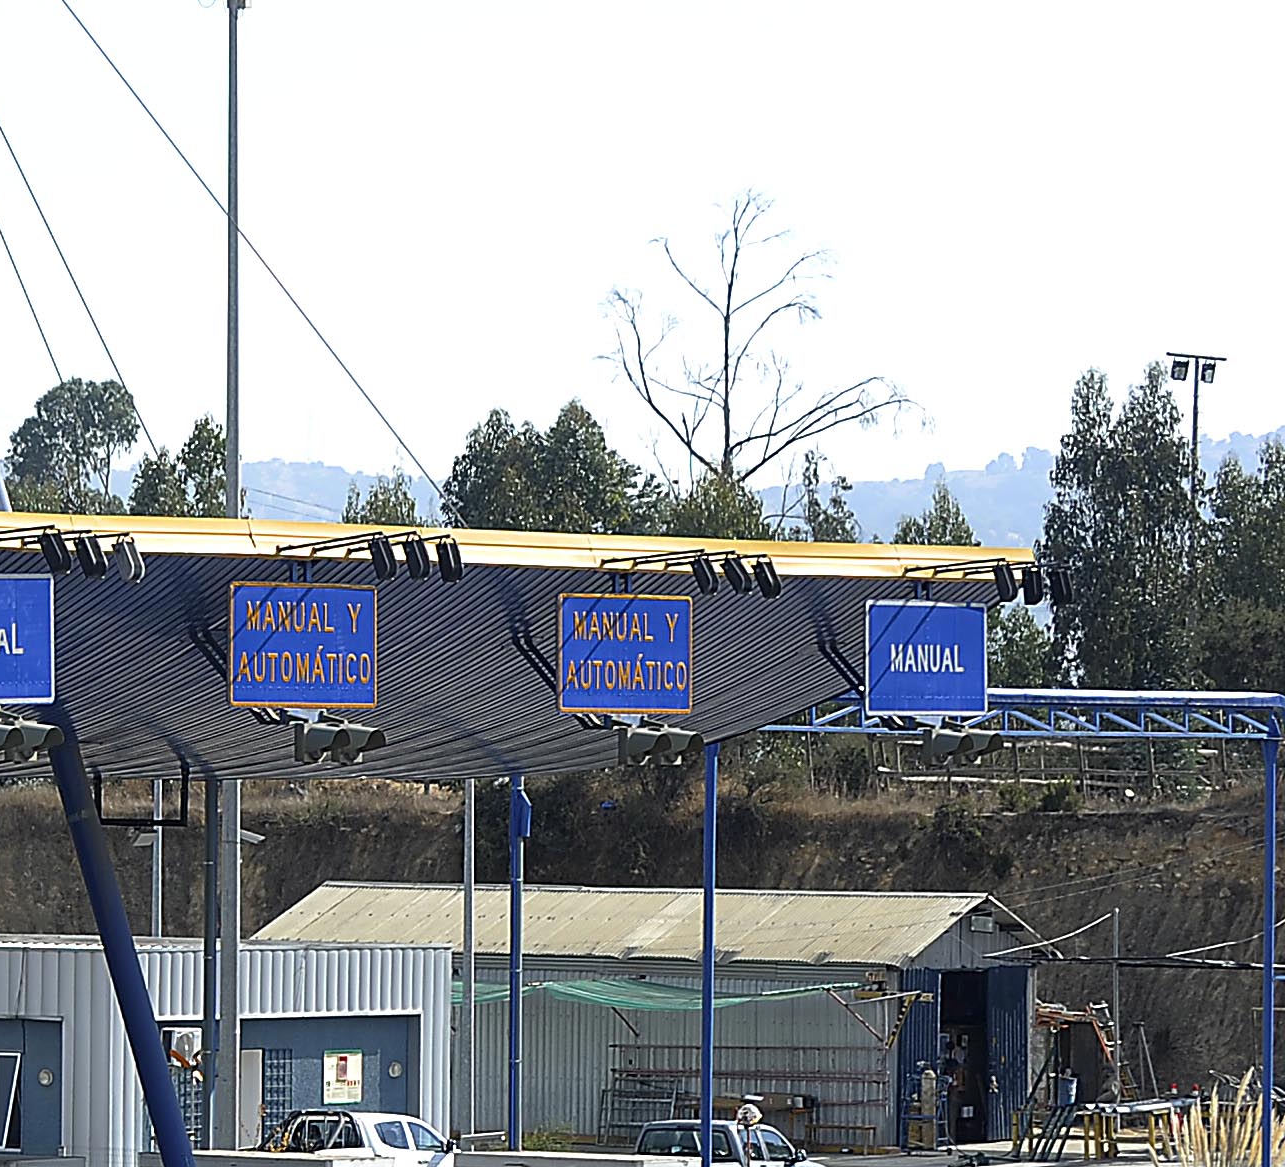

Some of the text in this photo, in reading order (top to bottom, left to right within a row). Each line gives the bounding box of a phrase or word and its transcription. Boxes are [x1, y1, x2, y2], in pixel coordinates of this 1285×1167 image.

[246, 600, 361, 633] MANUAL Y
[573, 610, 679, 643] MANUAL Y
[236, 645, 372, 684] AUTOMÁTICO
[566, 653, 688, 691] AUTOMÁTICO
[890, 643, 965, 673] MANUAL
